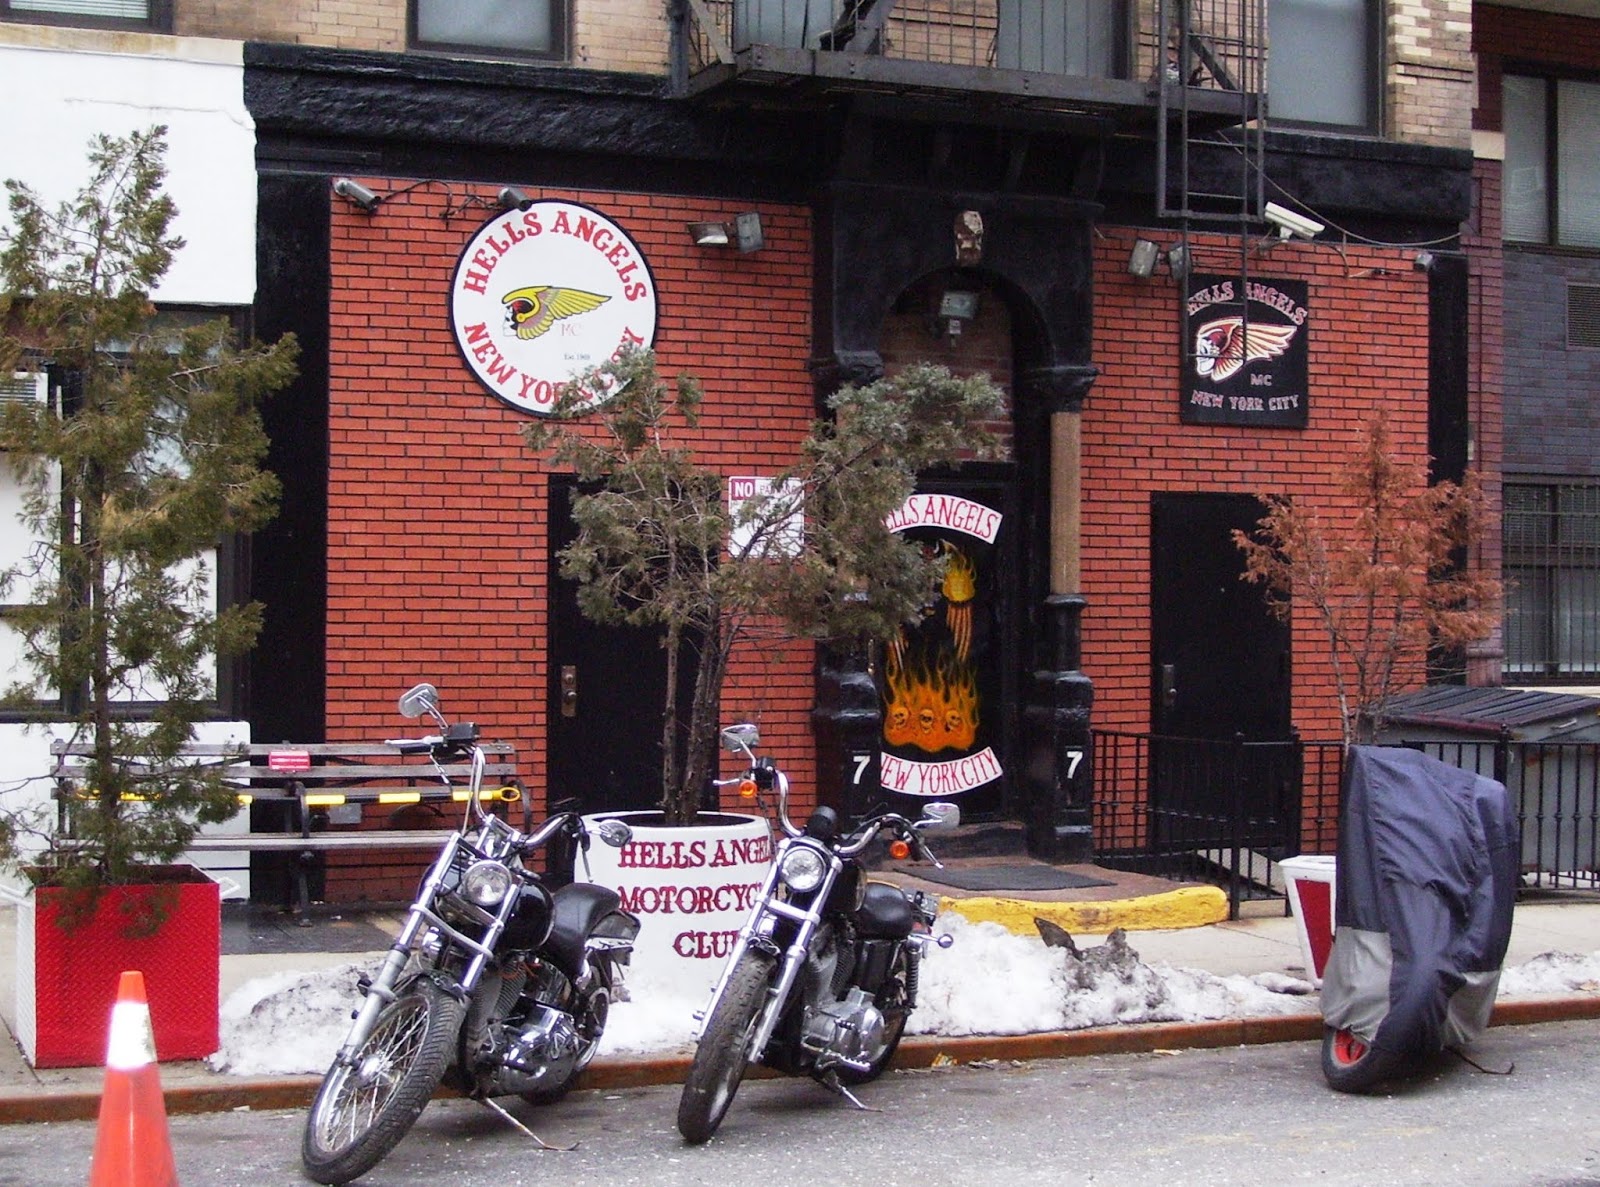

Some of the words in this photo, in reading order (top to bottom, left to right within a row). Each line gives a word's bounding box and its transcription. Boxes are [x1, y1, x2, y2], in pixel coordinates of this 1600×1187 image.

[463, 212, 543, 295] HELLS
[550, 211, 647, 302] ANGELS
[464, 322, 517, 386] NEW
[1250, 373, 1273, 386] MC
[1190, 389, 1224, 409] NEW
[1229, 396, 1265, 412] YORK
[1268, 394, 1299, 411] CITY
[734, 481, 754, 498] NO
[882, 497, 919, 530] ELLS
[922, 496, 999, 539] ANGELS
[852, 755, 871, 785] 7
[918, 761, 963, 794] YORK
[960, 748, 998, 787] CITY
[1066, 751, 1084, 779] 7
[617, 841, 706, 869] HELLS
[709, 835, 772, 868] ANGEL
[617, 882, 763, 914] MOTORCYC
[672, 930, 741, 959] CLU
